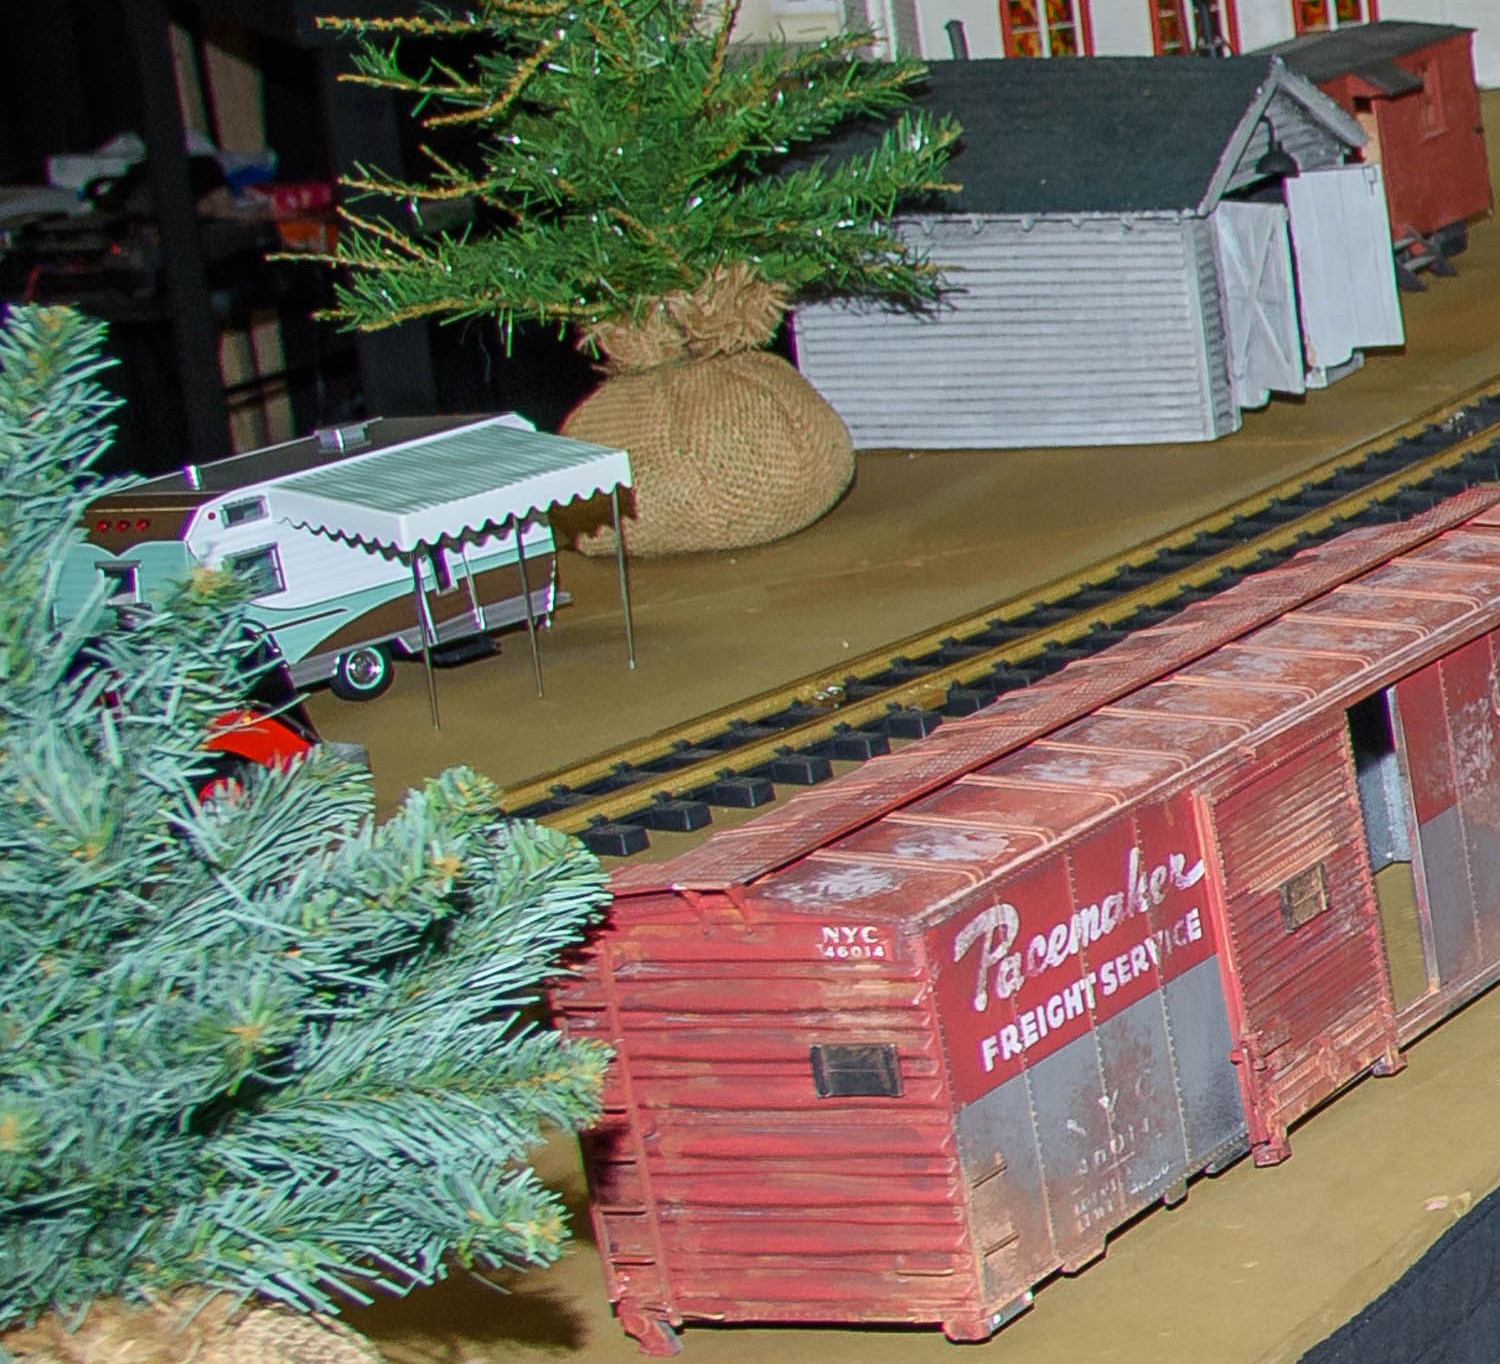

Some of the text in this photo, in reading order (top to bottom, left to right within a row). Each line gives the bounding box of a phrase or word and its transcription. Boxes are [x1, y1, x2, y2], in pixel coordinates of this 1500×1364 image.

[821, 926, 879, 944] NYC
[953, 847, 1206, 1012] Pacemaker
[979, 907, 1203, 1073] FREIGHT SERVICE
